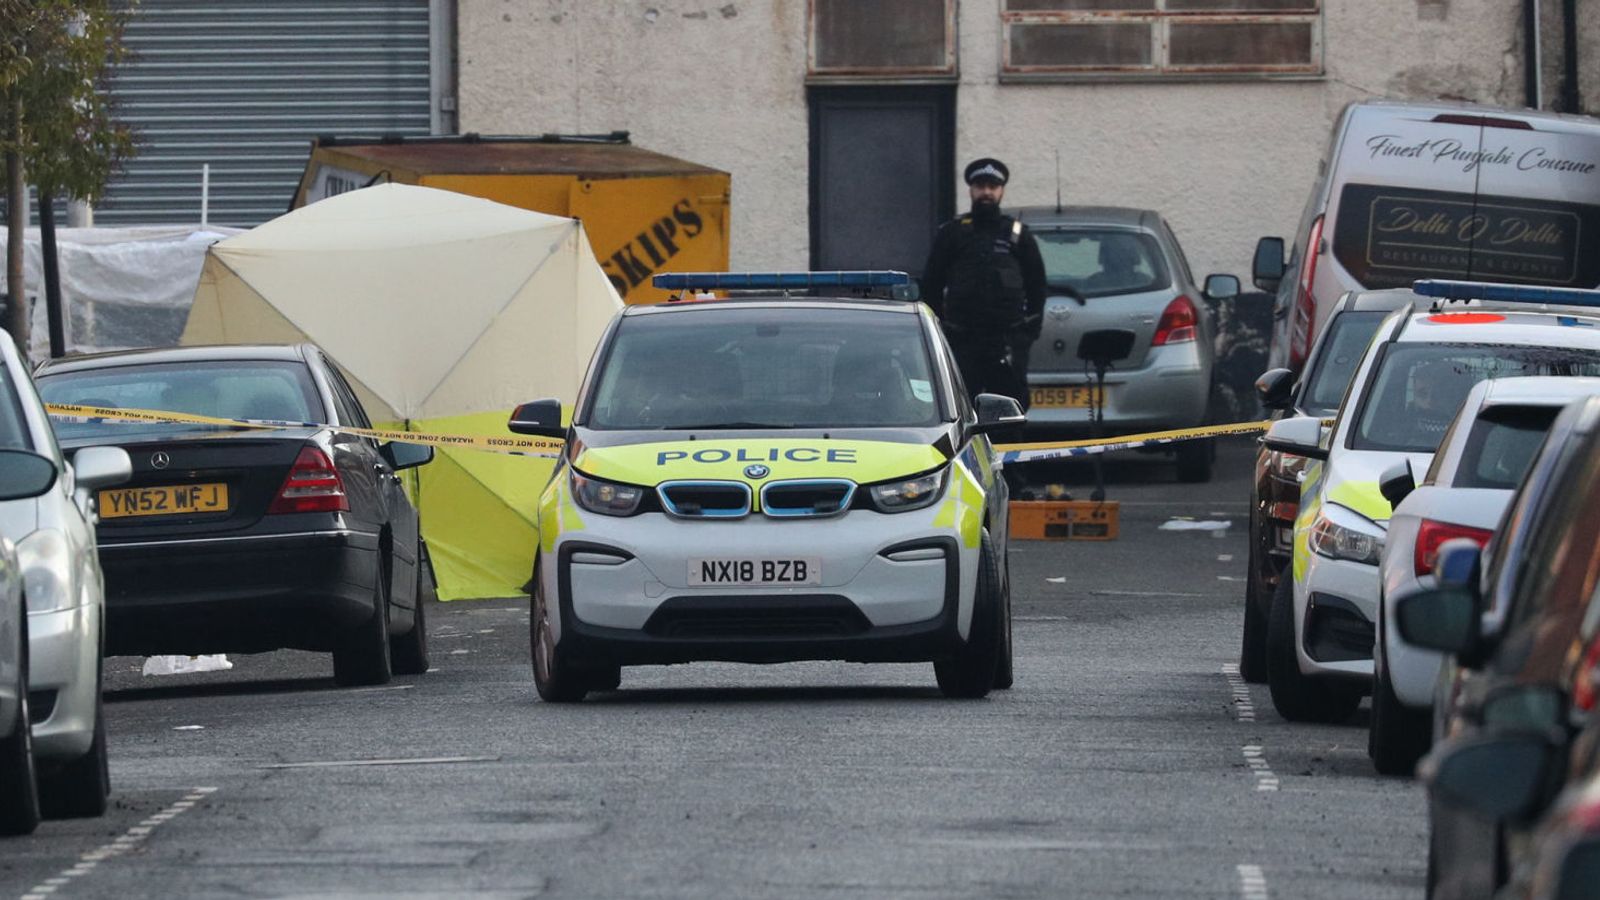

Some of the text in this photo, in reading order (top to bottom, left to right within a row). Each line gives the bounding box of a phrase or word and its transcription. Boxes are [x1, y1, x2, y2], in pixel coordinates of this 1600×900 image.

[1366, 134, 1430, 159] Finest
[1429, 138, 1514, 173] Punjabi
[1376, 206, 1565, 245] Delhi O Delhi
[1383, 250, 1480, 267] RESTAURANT
[384, 432, 401, 440] NOT
[441, 436, 475, 444] HAZARD
[487, 438, 514, 446] CROSS
[516, 439, 533, 447] NOT
[534, 440, 547, 448] DO
[657, 447, 858, 466] POLICE
[109, 489, 167, 513] YN52
[702, 560, 808, 583] NX18 BZB
